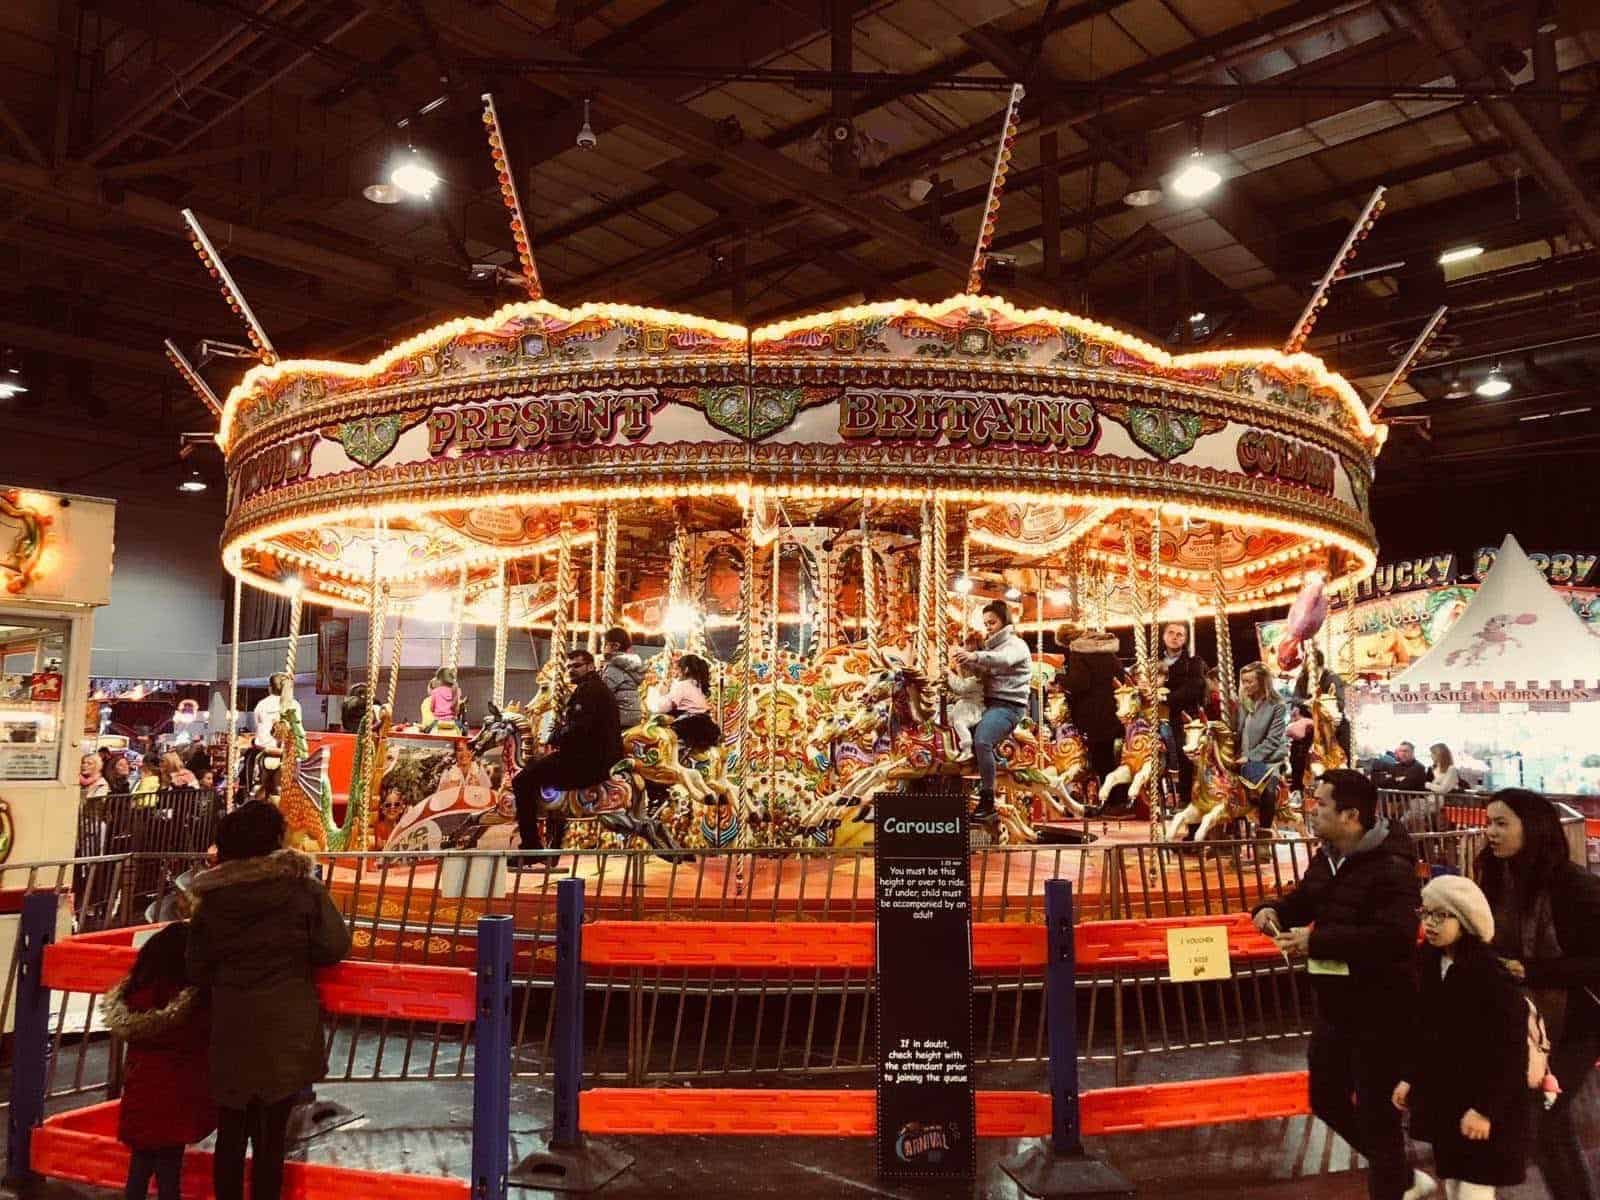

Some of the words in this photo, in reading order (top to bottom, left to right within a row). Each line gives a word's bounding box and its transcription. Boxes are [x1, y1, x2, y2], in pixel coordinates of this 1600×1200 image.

[428, 388, 660, 456] PRESENT
[839, 386, 1099, 453] BRITAINS
[1475, 547, 1597, 583] DBY
[883, 817, 960, 834] Carousel
[890, 866, 905, 875] You
[906, 867, 926, 875] must
[928, 866, 939, 875] be
[940, 866, 956, 875] this
[880, 878, 904, 888] height
[938, 878, 947, 886] to
[884, 888, 893, 897] If
[921, 888, 940, 897] child
[942, 889, 961, 897] must
[880, 899, 891, 908] be
[892, 900, 942, 909] accompanied
[944, 900, 954, 910] by
[912, 911, 933, 919] adult
[900, 1039, 909, 1048] If
[913, 1039, 921, 1048] in
[888, 1050, 912, 1059] check
[915, 1050, 941, 1061] height
[944, 1051, 963, 1059] with
[884, 1062, 899, 1071] the
[902, 1062, 943, 1071] attendant
[946, 1062, 967, 1072] prior
[884, 1074, 893, 1082] to
[895, 1074, 923, 1084] joining
[926, 1074, 940, 1082] the
[943, 1075, 968, 1084] queue
